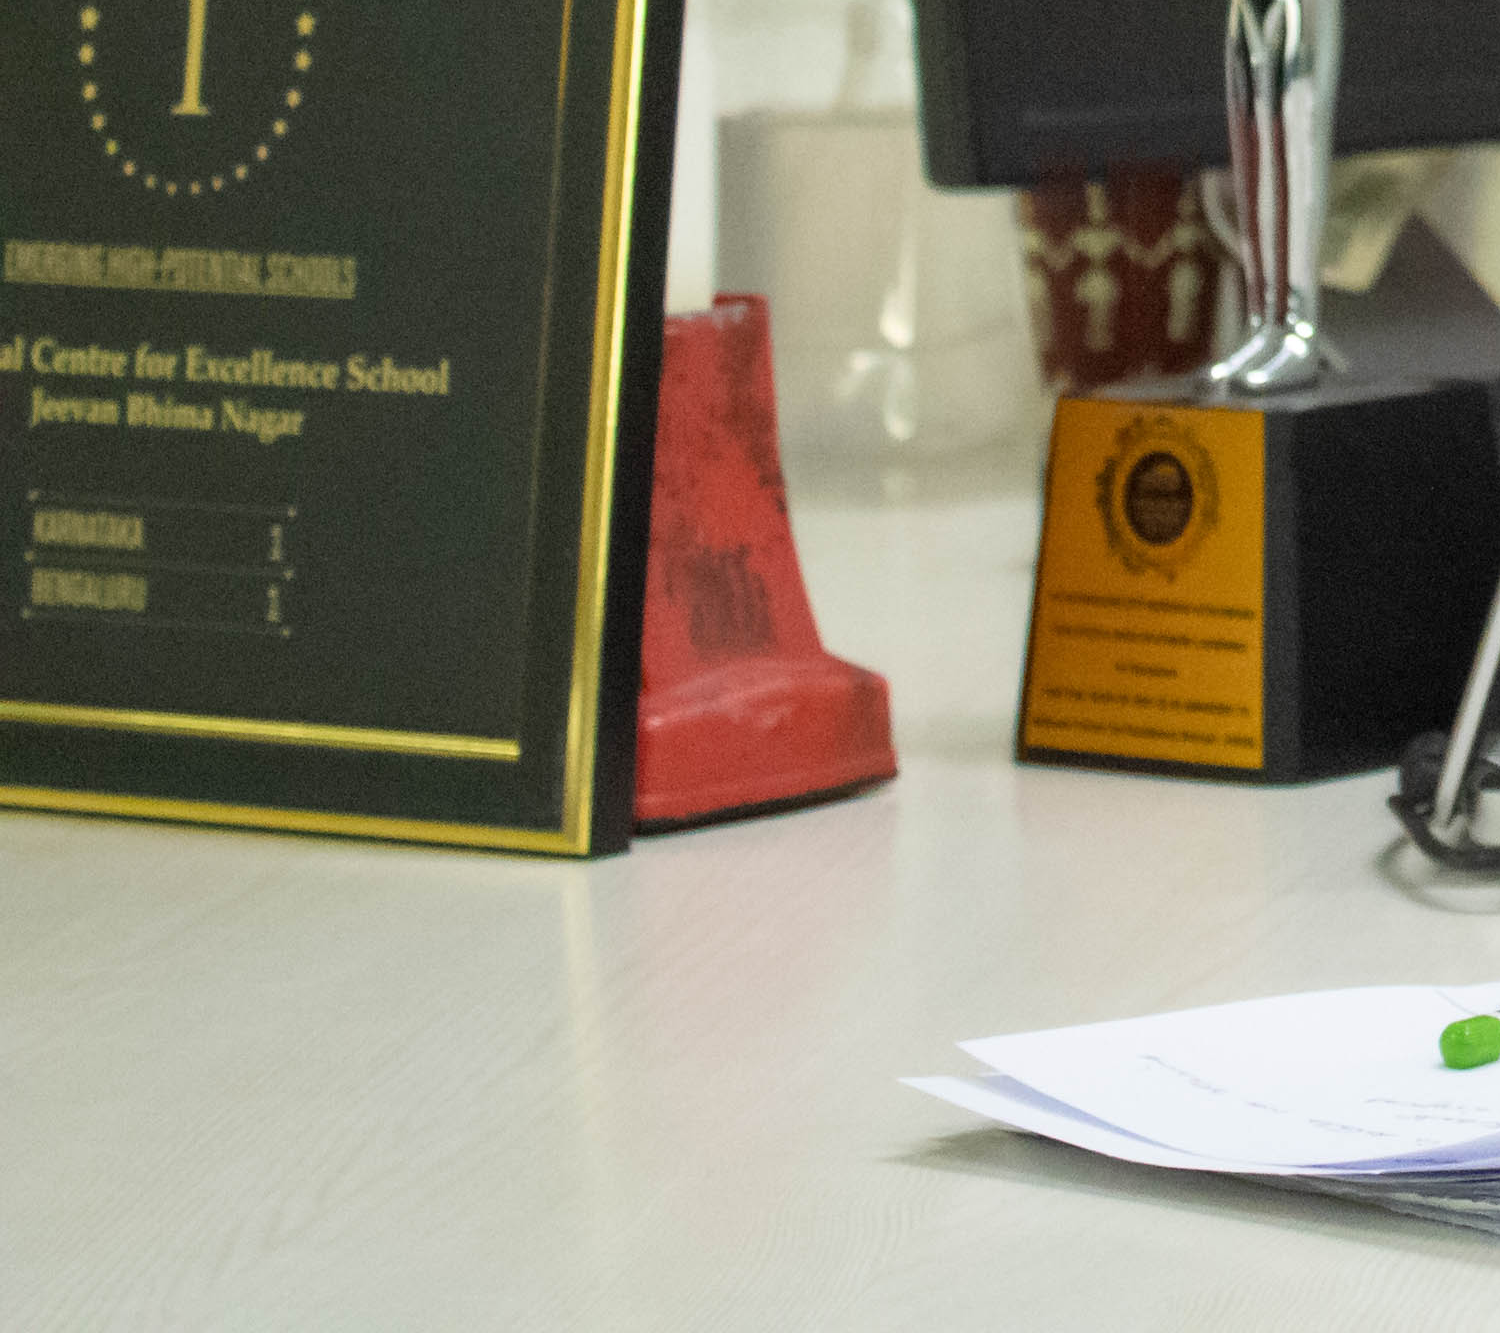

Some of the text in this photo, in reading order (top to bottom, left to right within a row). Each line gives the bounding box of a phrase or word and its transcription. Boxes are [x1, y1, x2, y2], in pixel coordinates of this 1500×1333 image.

[31, 337, 128, 378] Centre
[135, 342, 178, 381] for
[186, 345, 340, 391] Excellence
[346, 353, 450, 395] School
[30, 387, 305, 445] Jeevan Bhima Nagar
